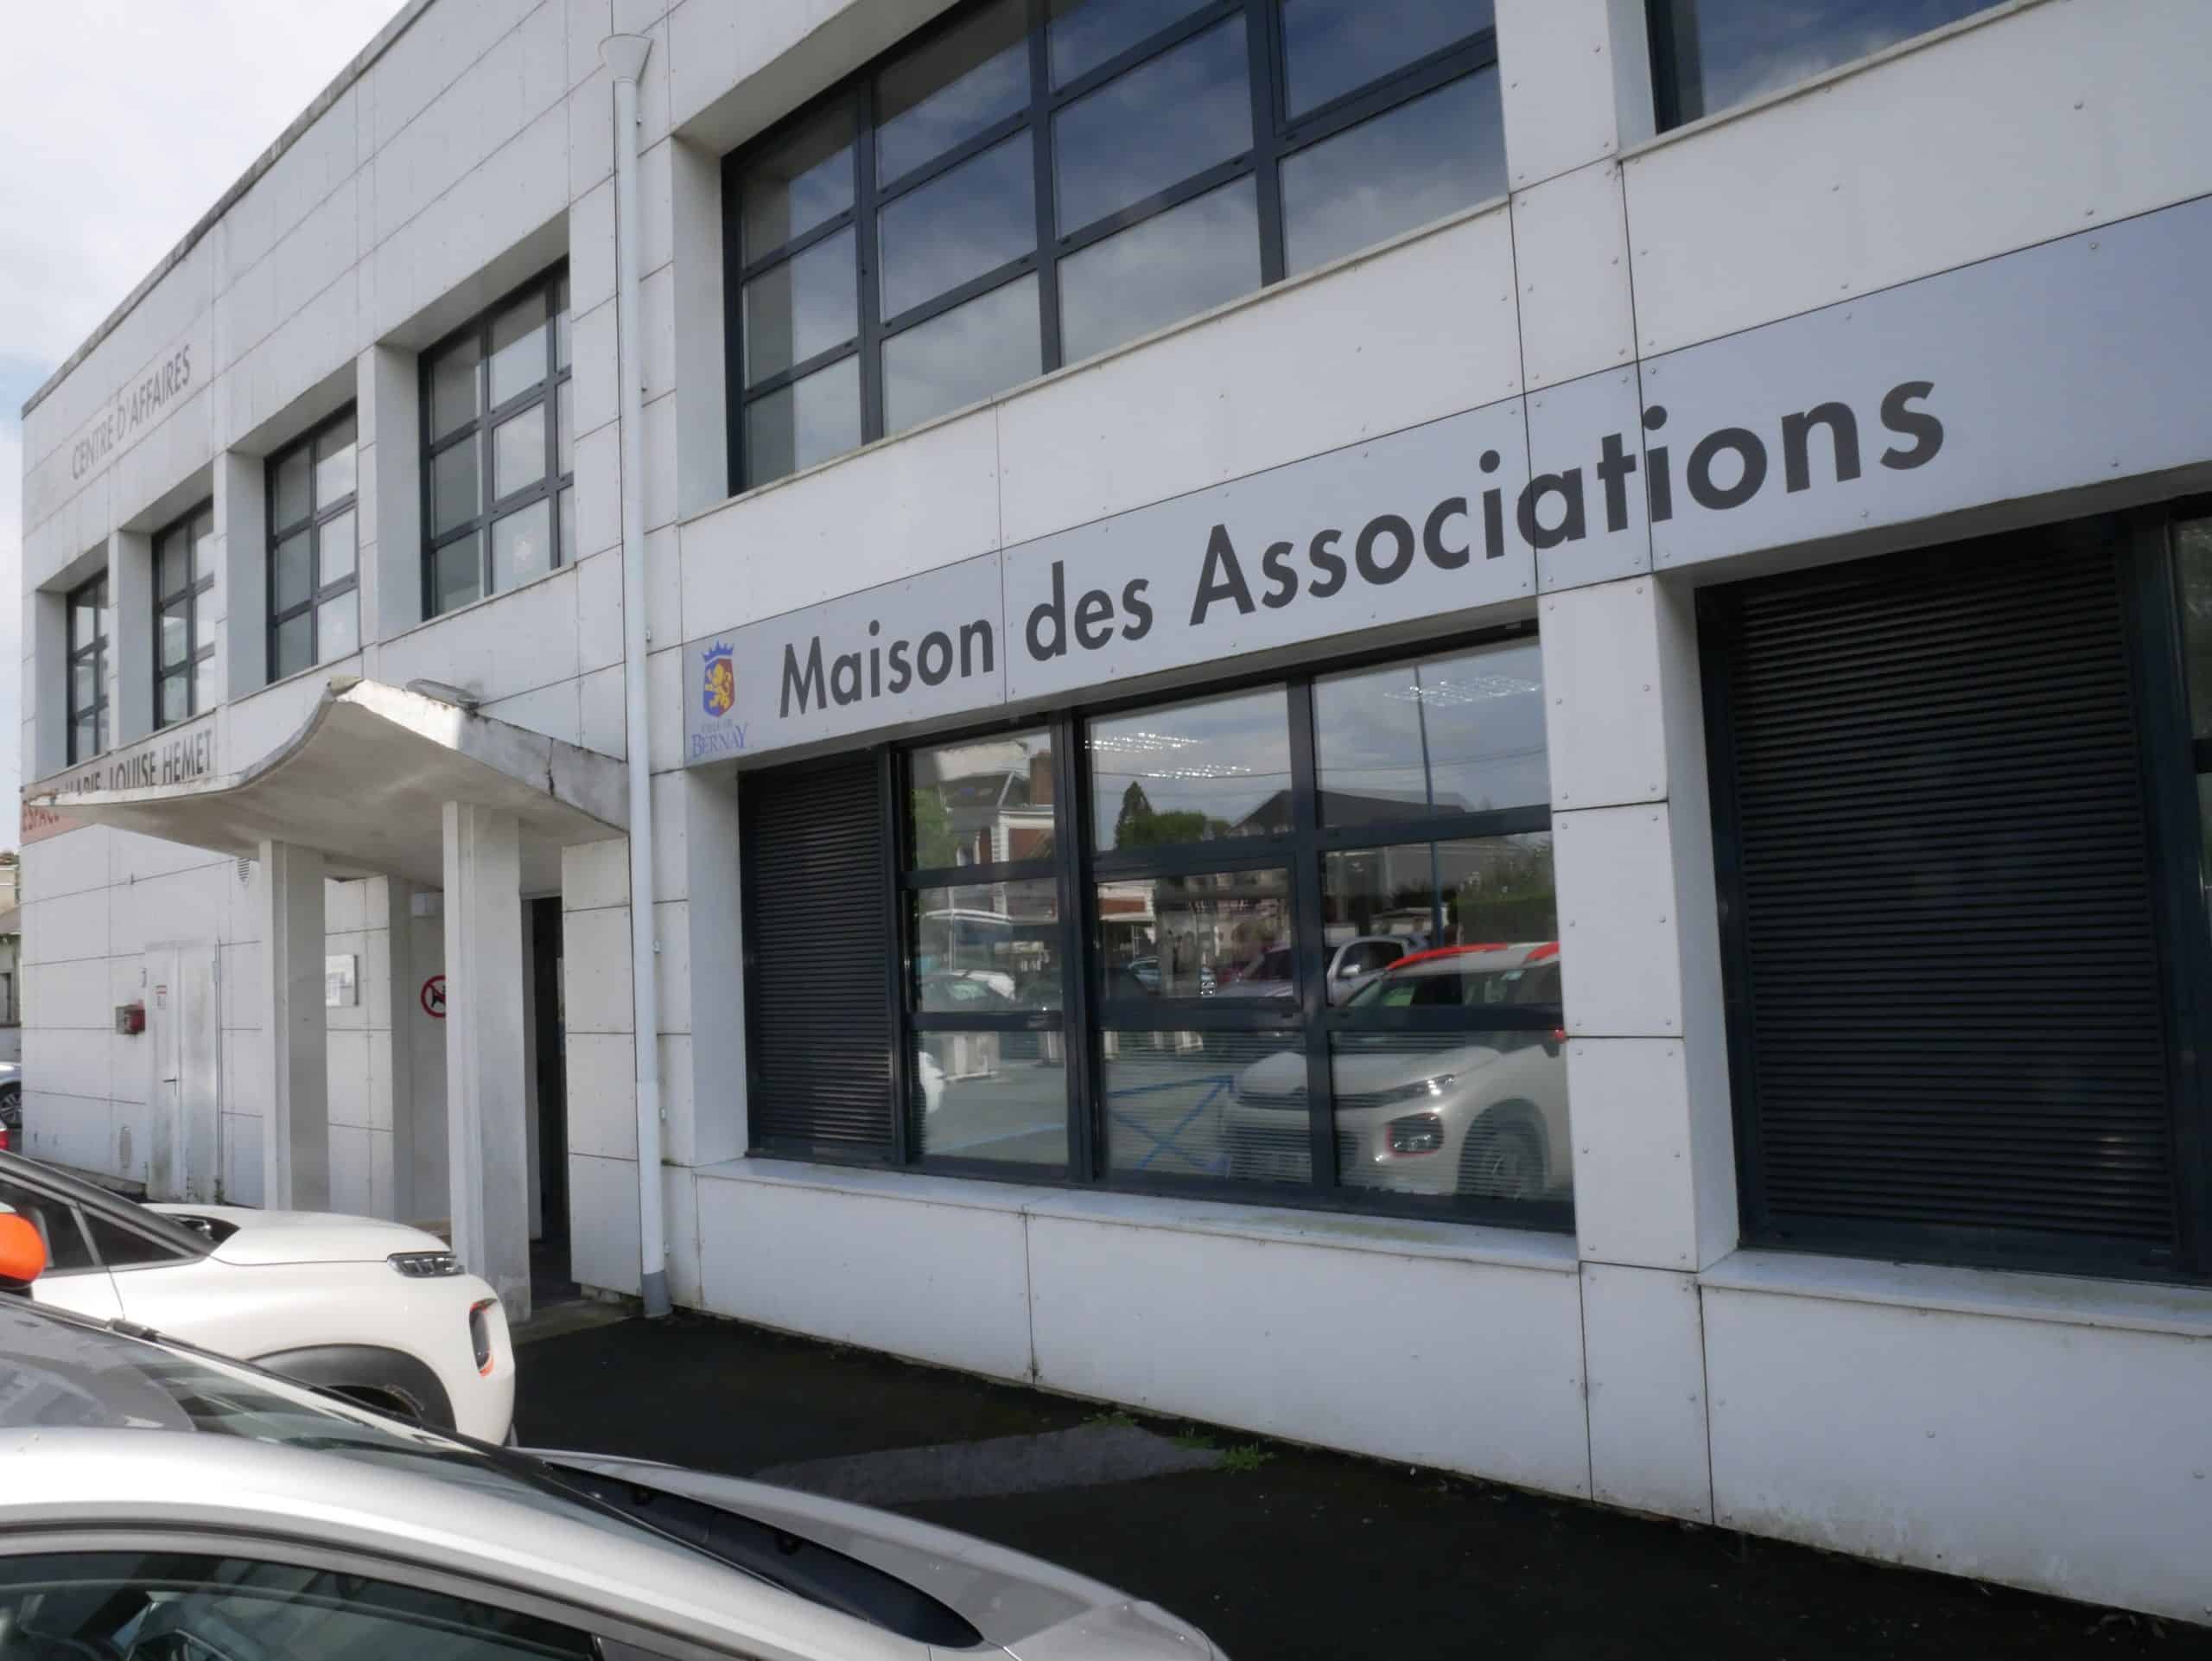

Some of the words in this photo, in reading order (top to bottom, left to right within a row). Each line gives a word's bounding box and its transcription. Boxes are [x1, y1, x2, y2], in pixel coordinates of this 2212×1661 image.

[72, 415, 113, 480] CENTRE
[118, 343, 190, 441] D'AFFAIRES
[779, 619, 994, 718] Maison
[1026, 560, 1153, 661] des
[1189, 380, 1944, 626] Associations
[162, 729, 212, 786] HEMET
